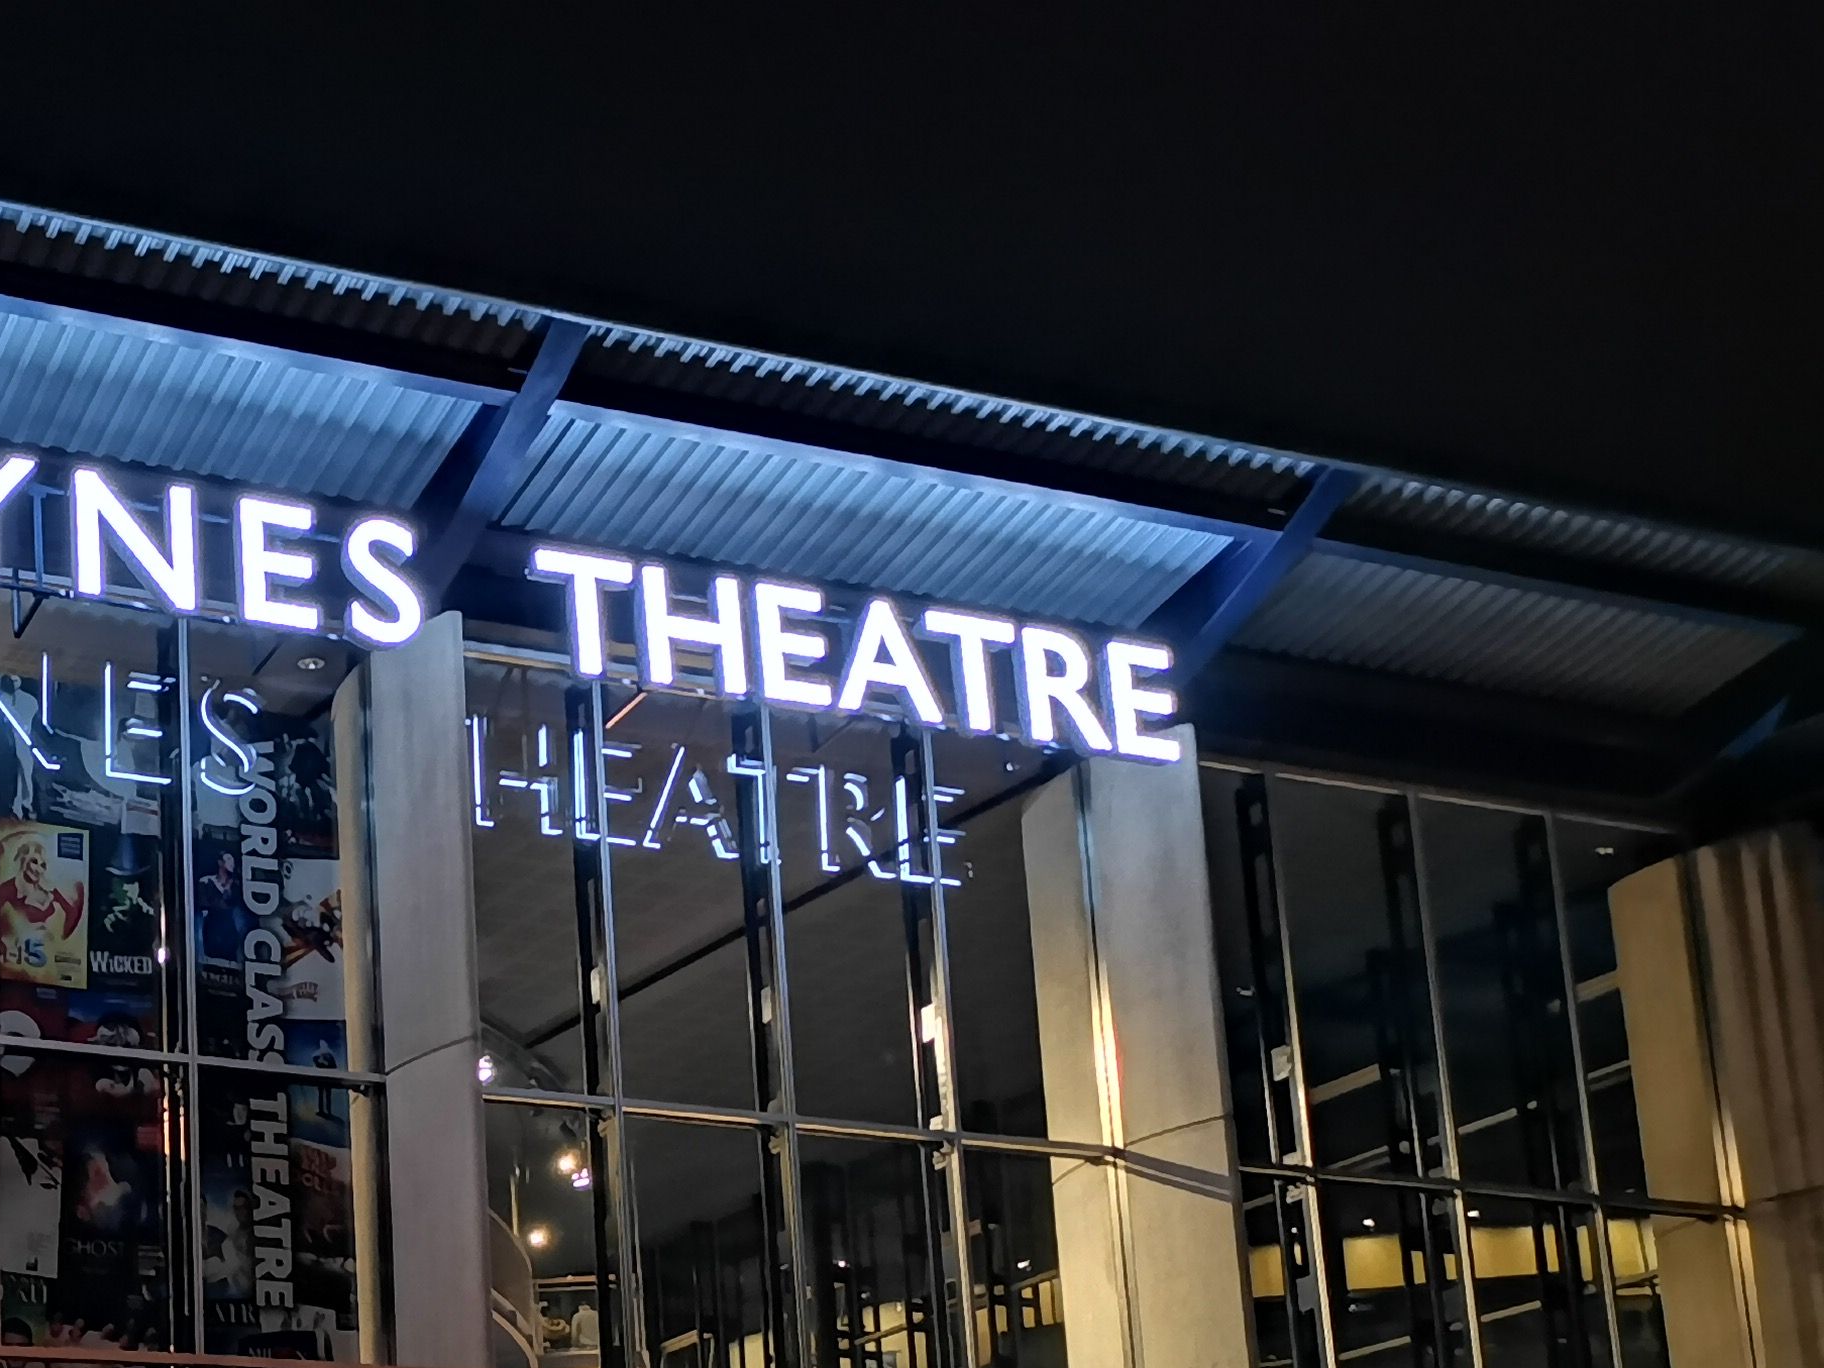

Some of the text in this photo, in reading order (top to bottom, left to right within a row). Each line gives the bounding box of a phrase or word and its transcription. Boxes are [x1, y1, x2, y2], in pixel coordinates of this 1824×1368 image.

[530, 548, 1181, 762] THEATRE
[238, 740, 282, 916] WORLD
[247, 1091, 295, 1309] THEATRE
